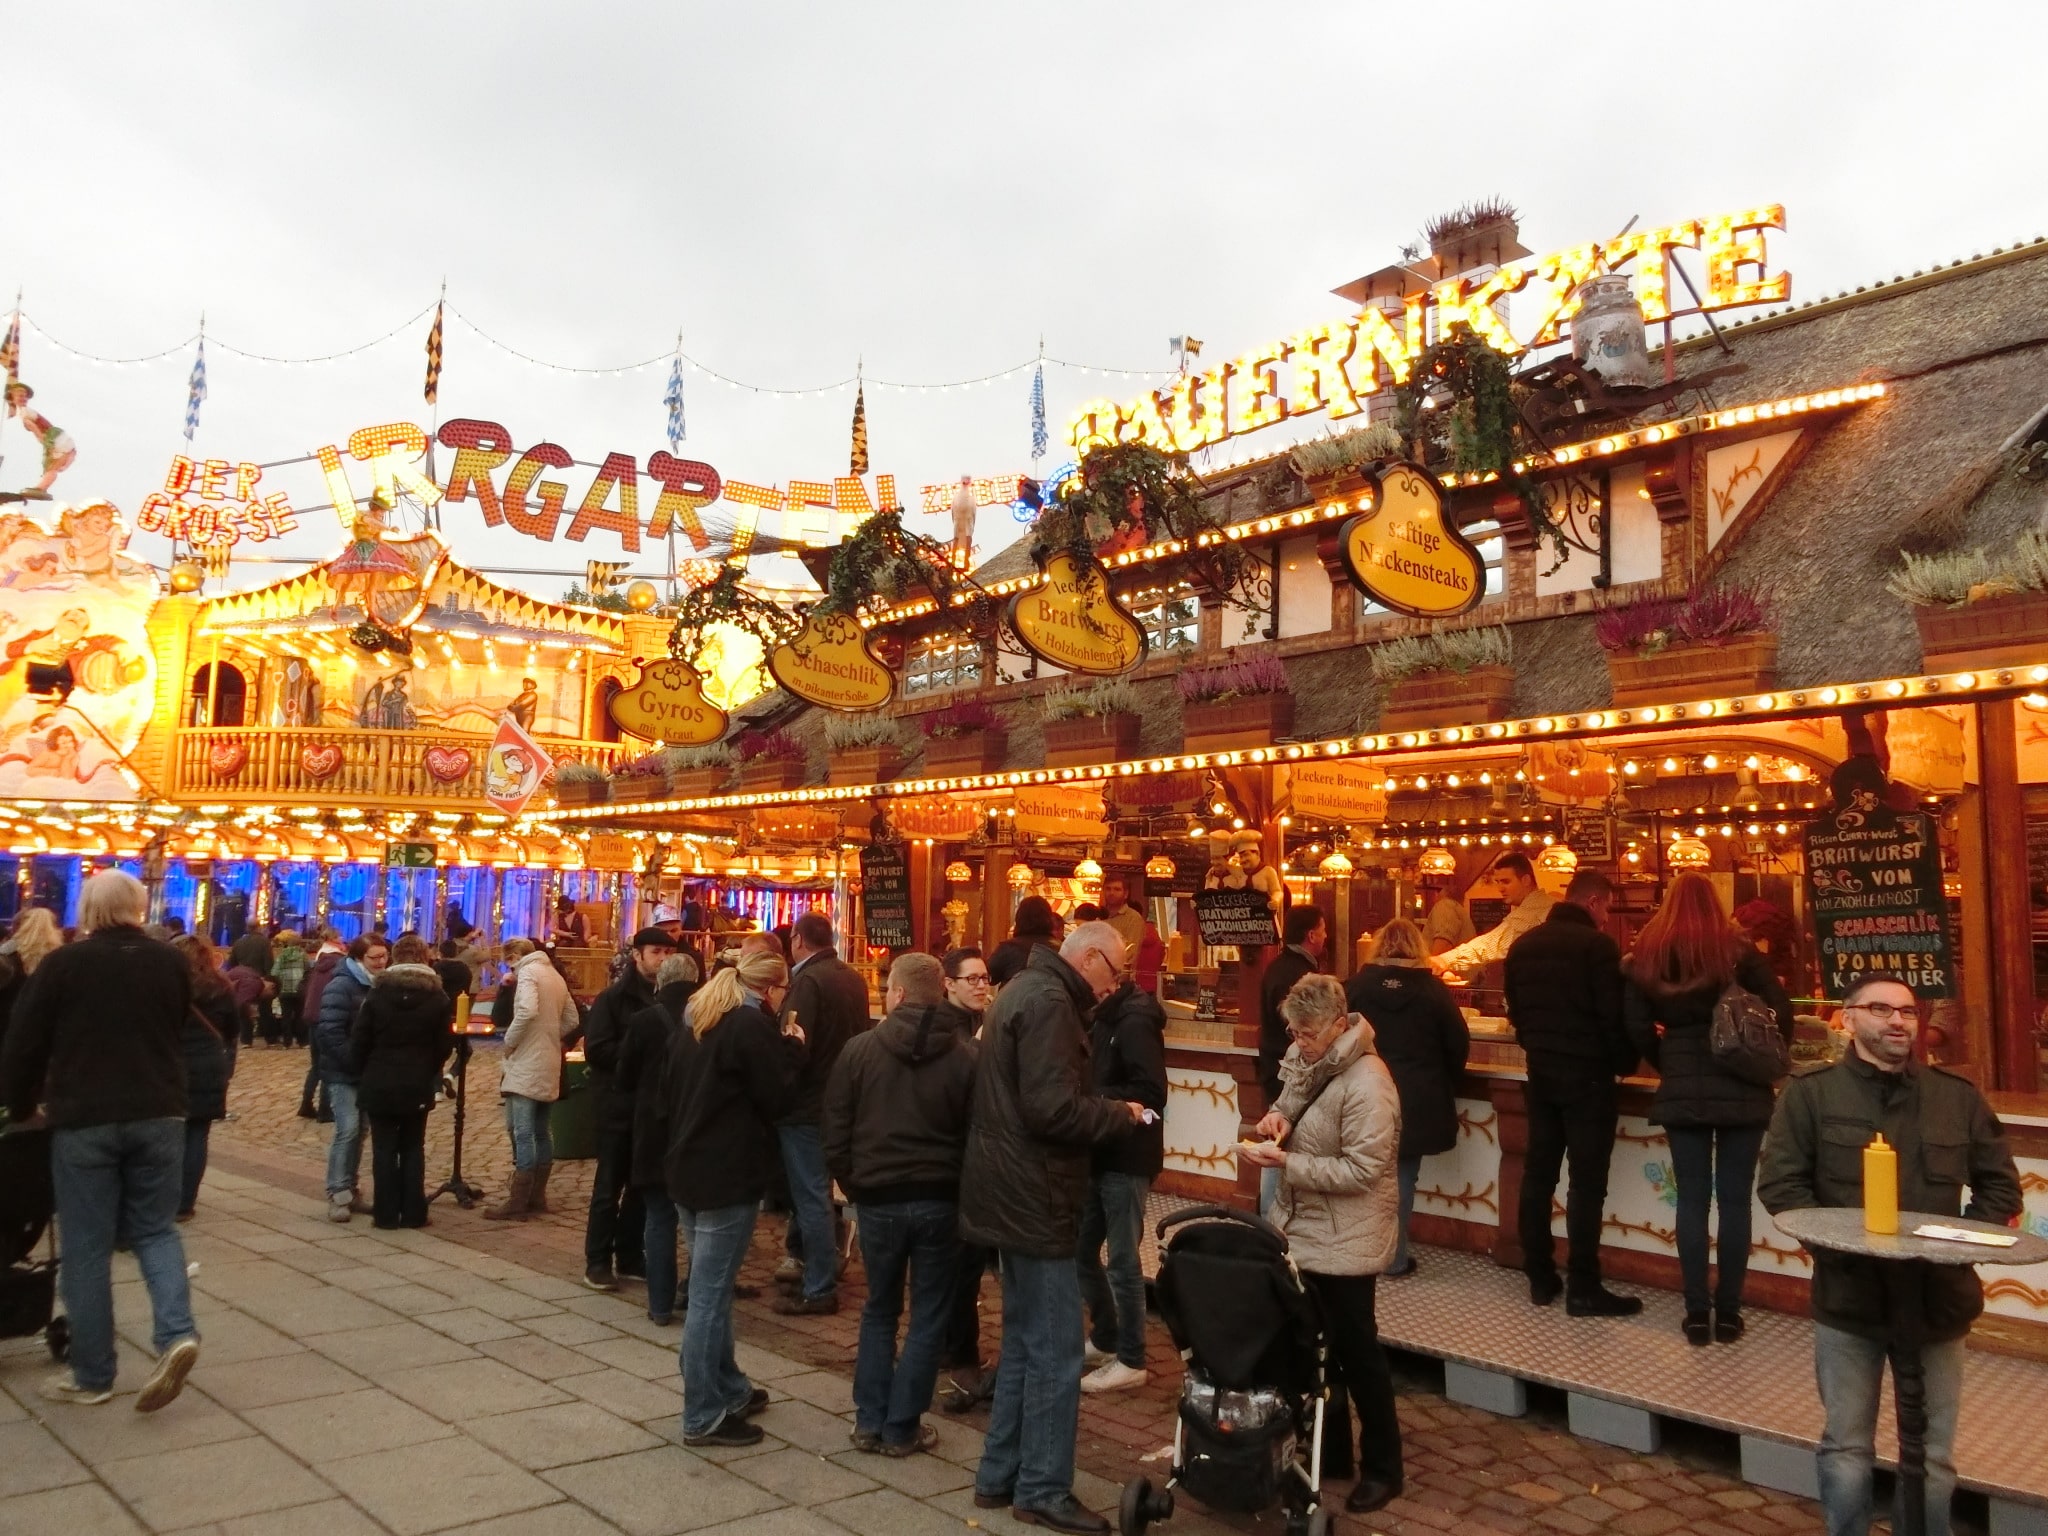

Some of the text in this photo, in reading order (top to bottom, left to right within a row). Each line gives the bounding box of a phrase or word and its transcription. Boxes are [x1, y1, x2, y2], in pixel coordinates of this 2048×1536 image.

[1064, 203, 1792, 455] BAUERNKATE
[164, 455, 262, 502] DER
[317, 418, 898, 568] IRRGARTEN
[138, 492, 298, 545] GROSSE
[1388, 520, 1440, 554] saftige
[1359, 540, 1468, 591] Nackensteaks
[1053, 580, 1104, 606] leckre
[1038, 599, 1126, 641] Bratwrst
[1045, 632, 1128, 666] Holzkohlengrill
[792, 655, 880, 686] Schaschlik
[638, 691, 704, 723] Gyros
[639, 722, 695, 739] mit Kraut
[1297, 768, 1383, 791] Leckere Bratwur
[1296, 793, 1383, 814] vom Holzkohlengrill
[1871, 868, 1912, 886] VOM
[1211, 894, 1249, 907] LECKERE
[1815, 888, 1923, 910] HOLZKOHLENROST
[1198, 907, 1251, 920] BRATWURST
[1833, 911, 1941, 936] SCHASCHLIK
[871, 936, 912, 946] KRAKAUER
[1837, 953, 1935, 970] POMMES
[1833, 970, 1945, 988] KRAUER
